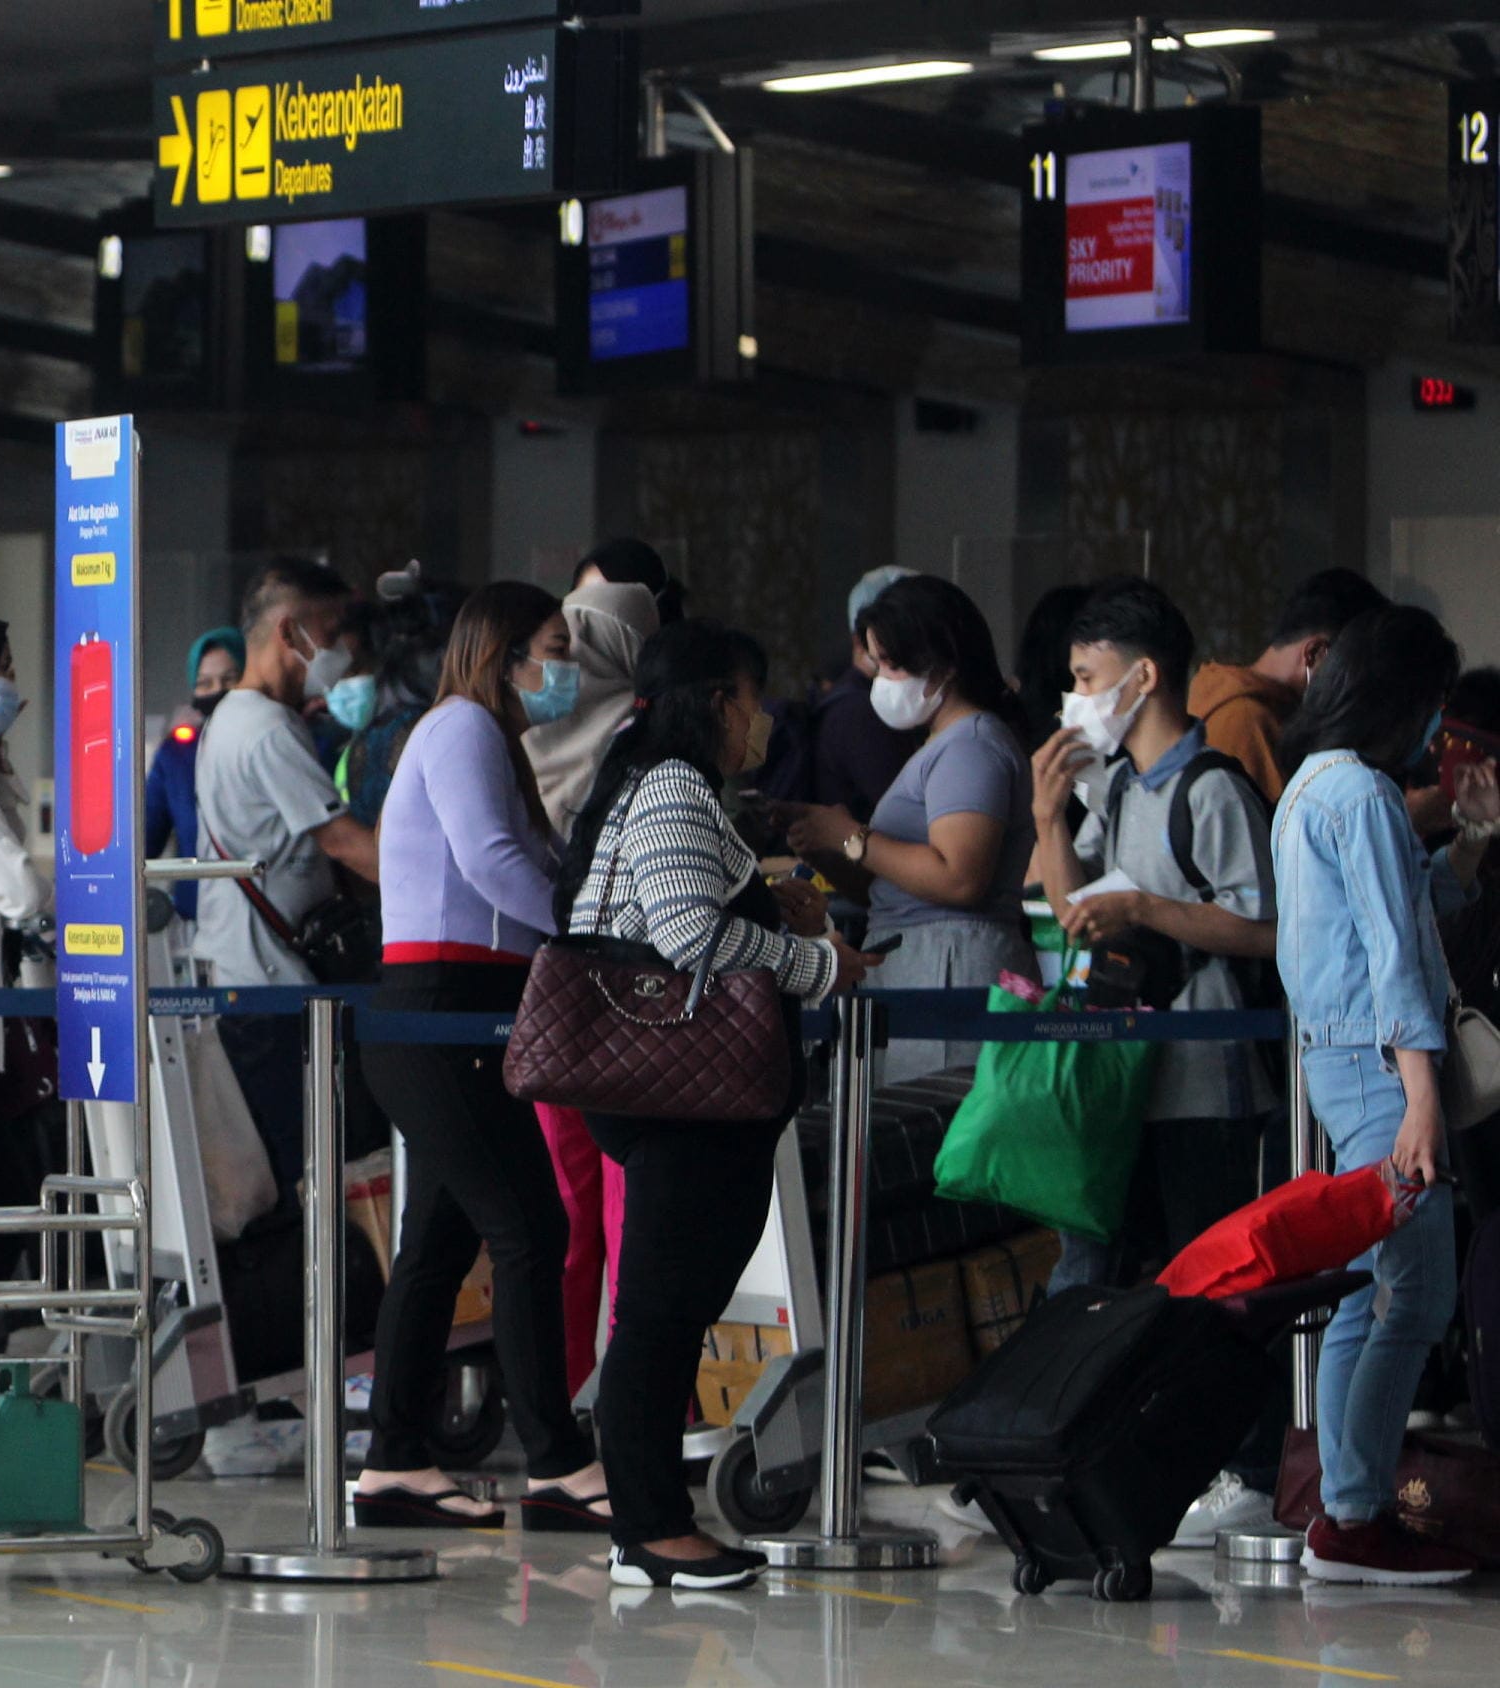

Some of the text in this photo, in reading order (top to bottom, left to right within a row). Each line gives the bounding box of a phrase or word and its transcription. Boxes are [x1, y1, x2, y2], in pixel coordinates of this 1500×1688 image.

[236, 0, 283, 32] Domestic
[275, 74, 403, 152] Keberangkatan
[524, 94, 547, 130] 出发
[1457, 111, 1488, 163] 12
[275, 159, 333, 204] Departures
[1030, 151, 1056, 200] 11
[559, 198, 584, 246] 10
[1068, 236, 1097, 260] SKY
[1068, 257, 1134, 284] PRIORITY
